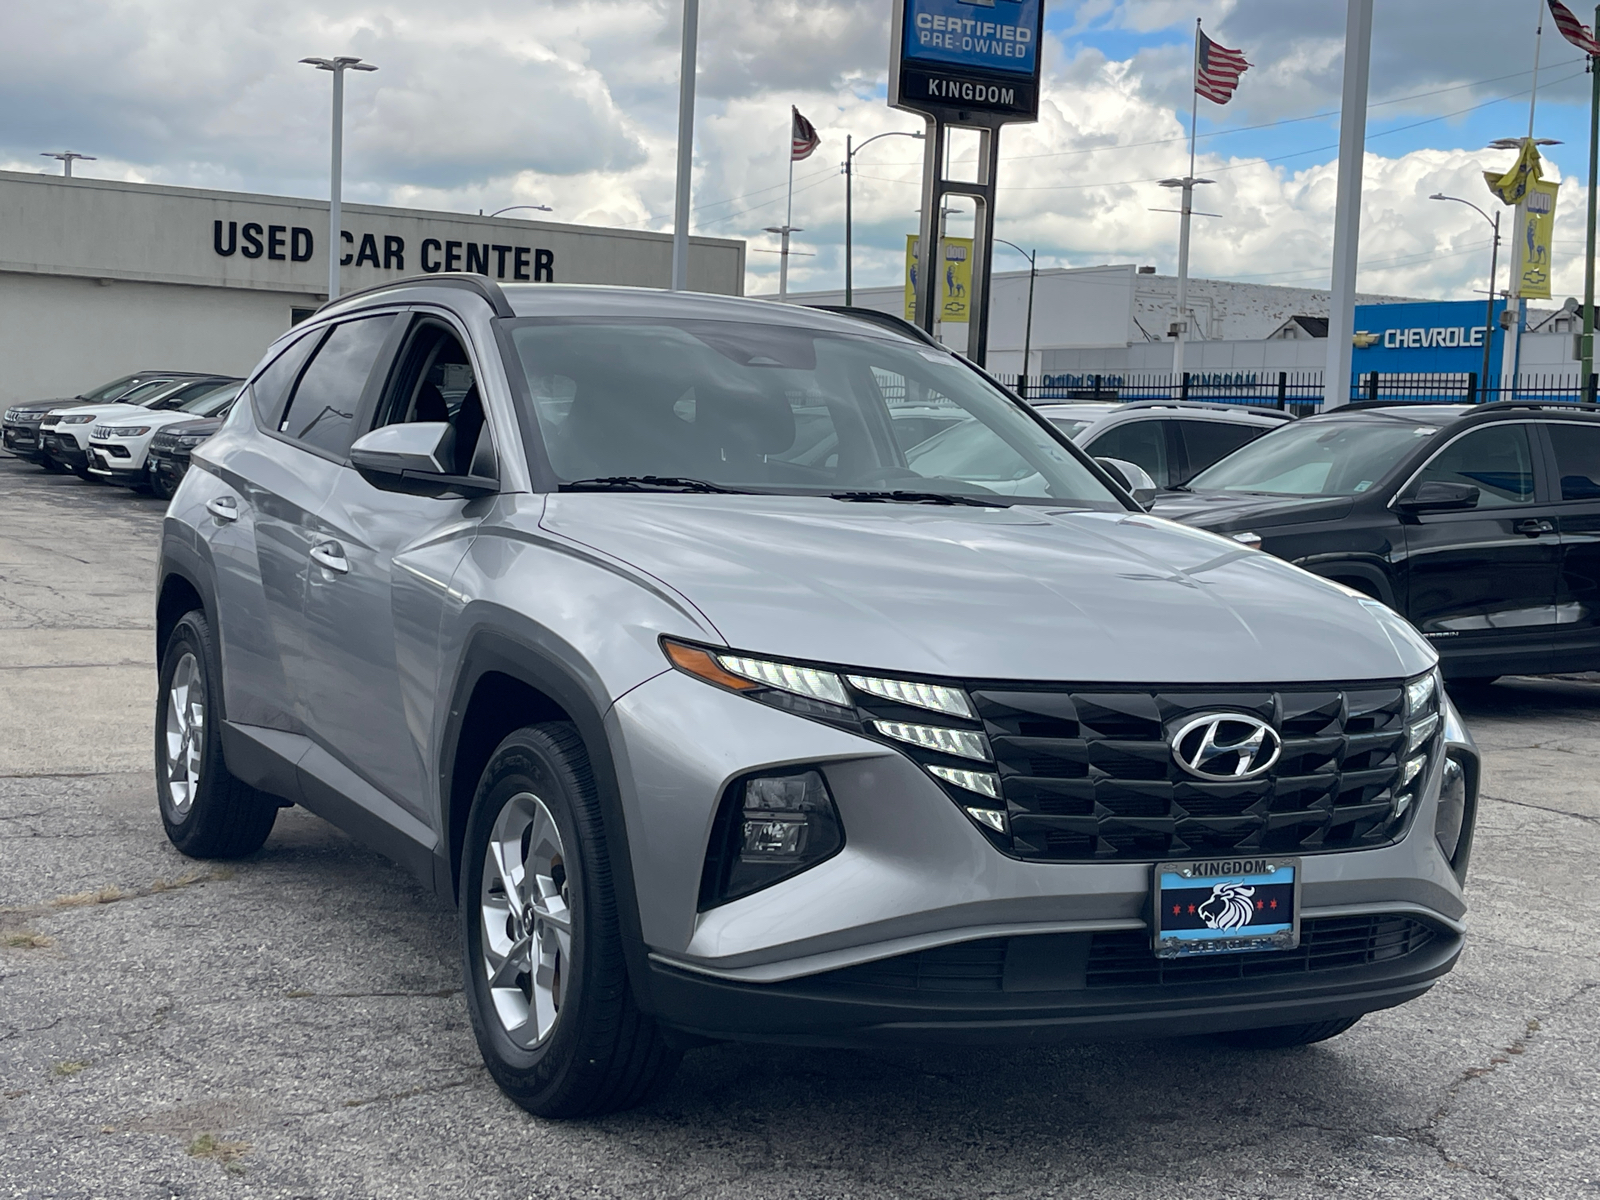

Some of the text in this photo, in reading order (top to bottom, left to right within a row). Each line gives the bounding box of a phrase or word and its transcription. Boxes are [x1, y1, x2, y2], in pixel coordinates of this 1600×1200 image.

[917, 13, 1031, 43] CERTIFIED
[920, 31, 1025, 58] PRE-OWNED
[928, 78, 1014, 105] KINGDOM
[213, 220, 555, 283] USED CAR CENTER
[1192, 860, 1267, 876] KINGDOM
